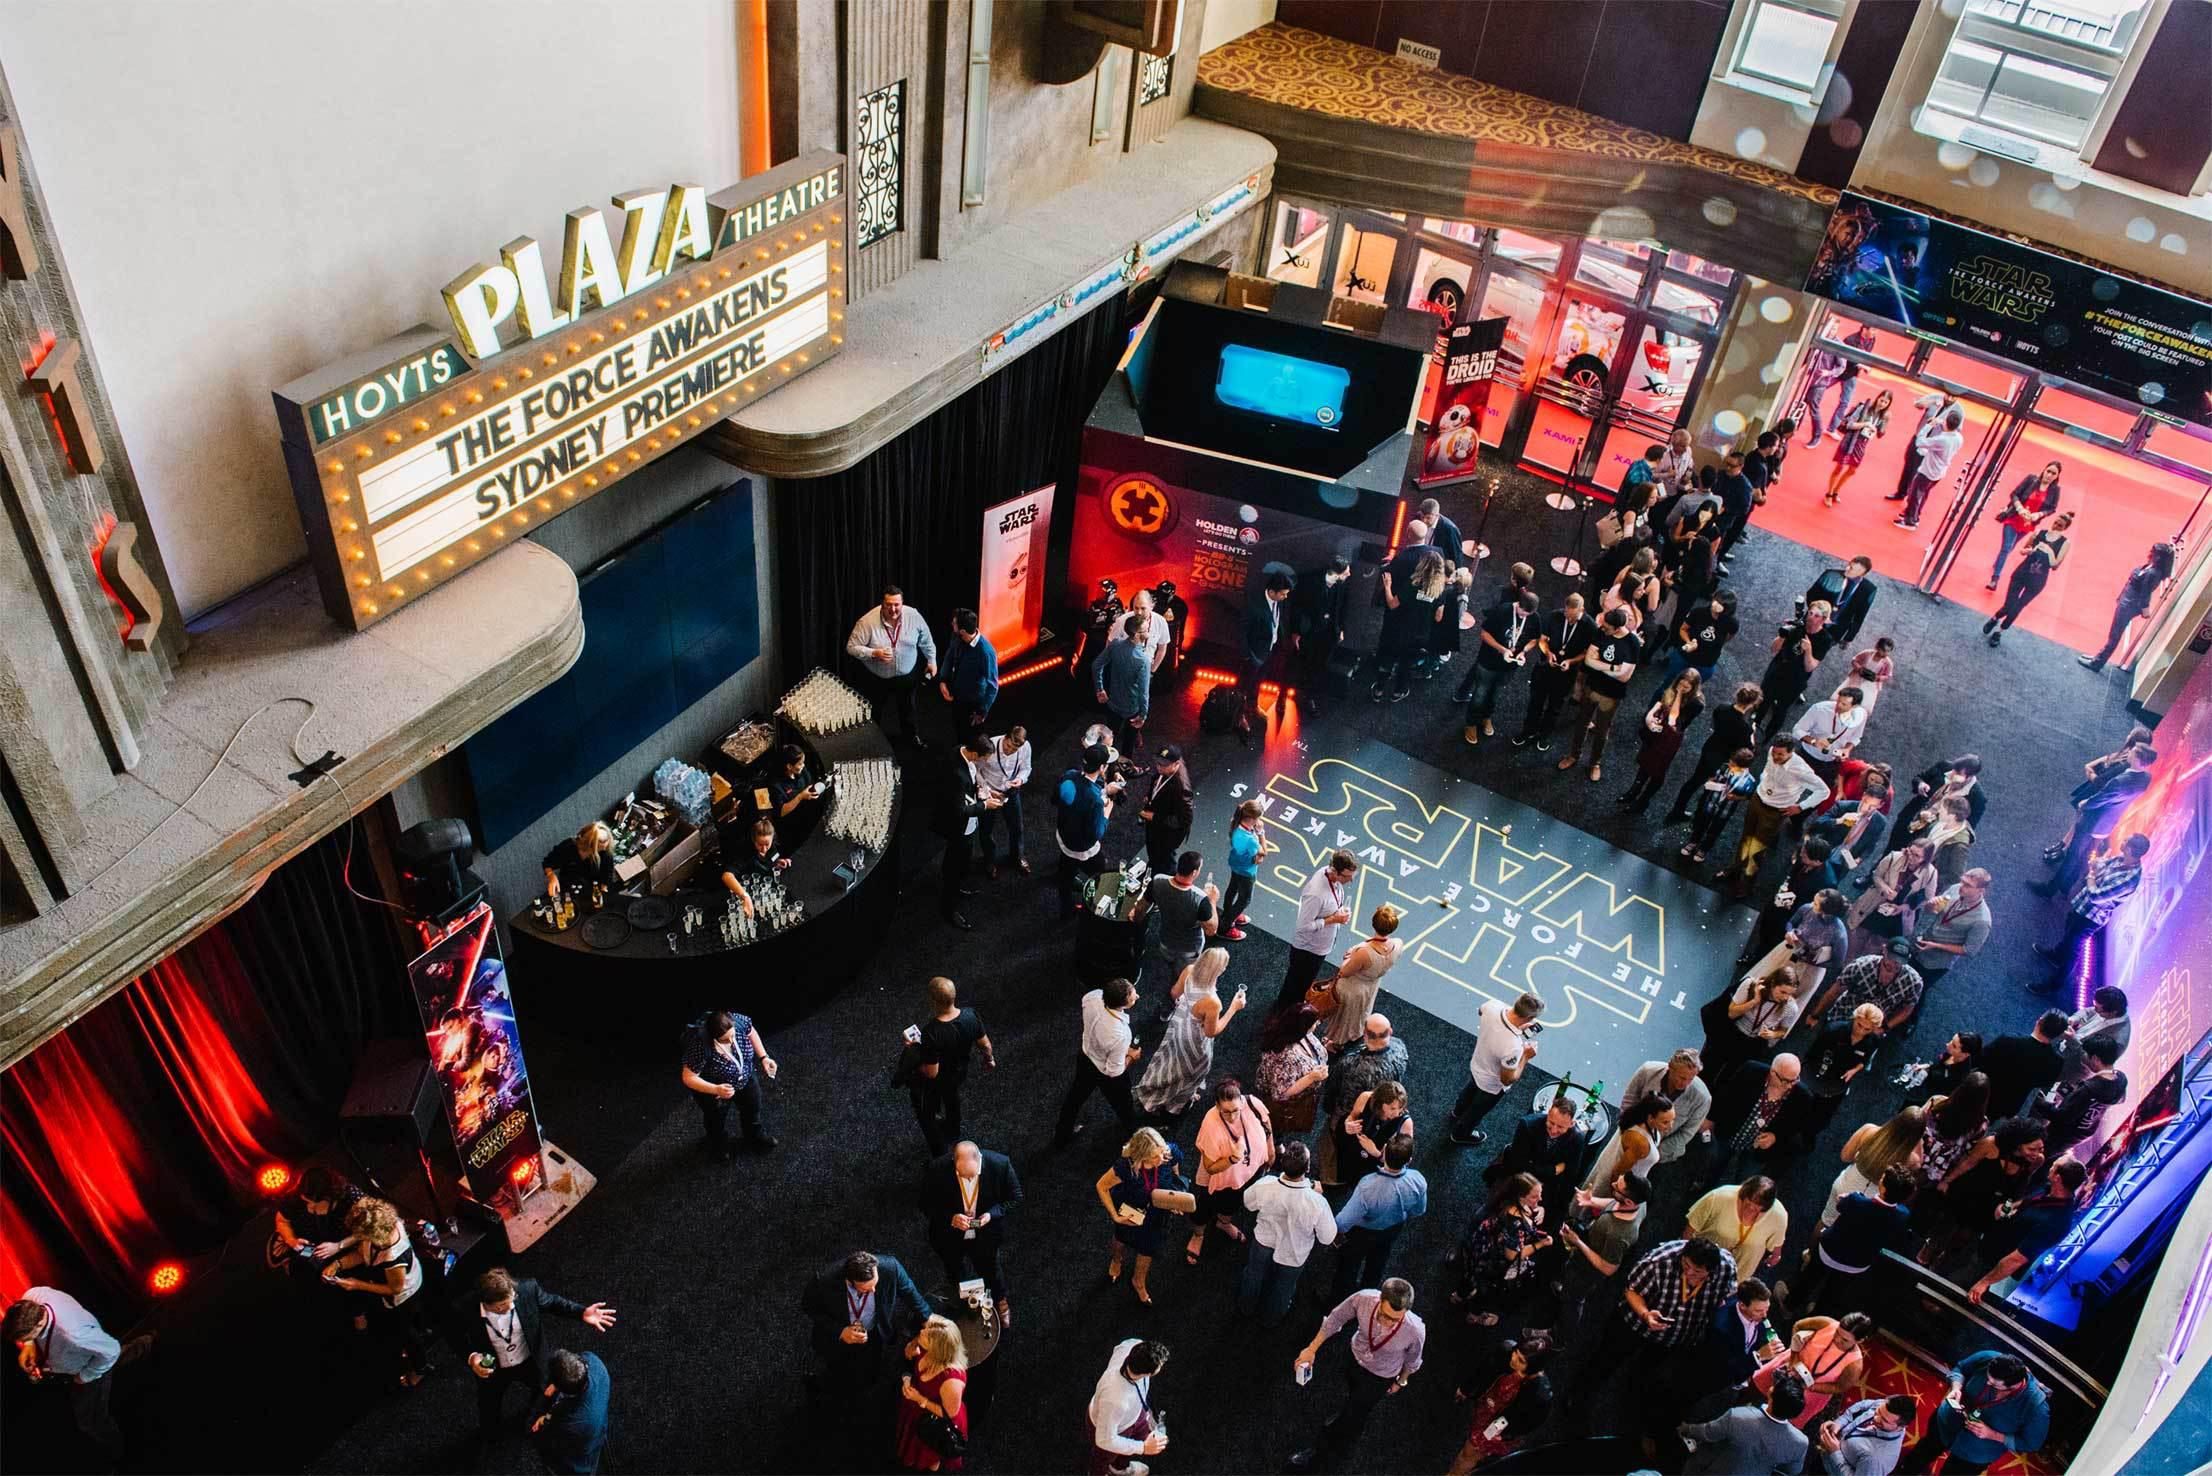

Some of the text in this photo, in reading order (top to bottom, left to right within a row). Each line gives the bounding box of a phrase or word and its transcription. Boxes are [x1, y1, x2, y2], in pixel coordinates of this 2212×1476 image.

[1400, 42, 1437, 61] NO ACCESS
[730, 167, 839, 242] THEATRE
[441, 183, 712, 359] PLAZA
[1948, 268, 2056, 308] THE FORCE AWAKENS
[1957, 255, 2054, 299] STAR
[1951, 276, 2047, 322] WARS
[2104, 307, 2122, 317] JOIN
[2123, 313, 2138, 322] THE
[2138, 318, 2194, 341] CONVERSATION
[1451, 350, 1497, 365] THIS IS THE
[2016, 340, 2040, 354] HOYTS
[2093, 325, 2206, 367] YOUR POST COULD BE FEATURED
[2111, 339, 2180, 366] ON THE BIG SCREEN
[436, 266, 788, 475] THE FORCE AWAKENS
[1446, 359, 1496, 380] DROID
[320, 348, 452, 436] HOYTS
[475, 330, 767, 520] SYDNEY PREMIERE
[999, 503, 1040, 526] STAR
[1000, 511, 1039, 535] WARS
[1195, 519, 1238, 536] HOLDEN
[1191, 563, 1246, 588] ZONE
[1265, 758, 1664, 976] WARS
[1229, 783, 1688, 1011] THE FORCE AWAKENS
